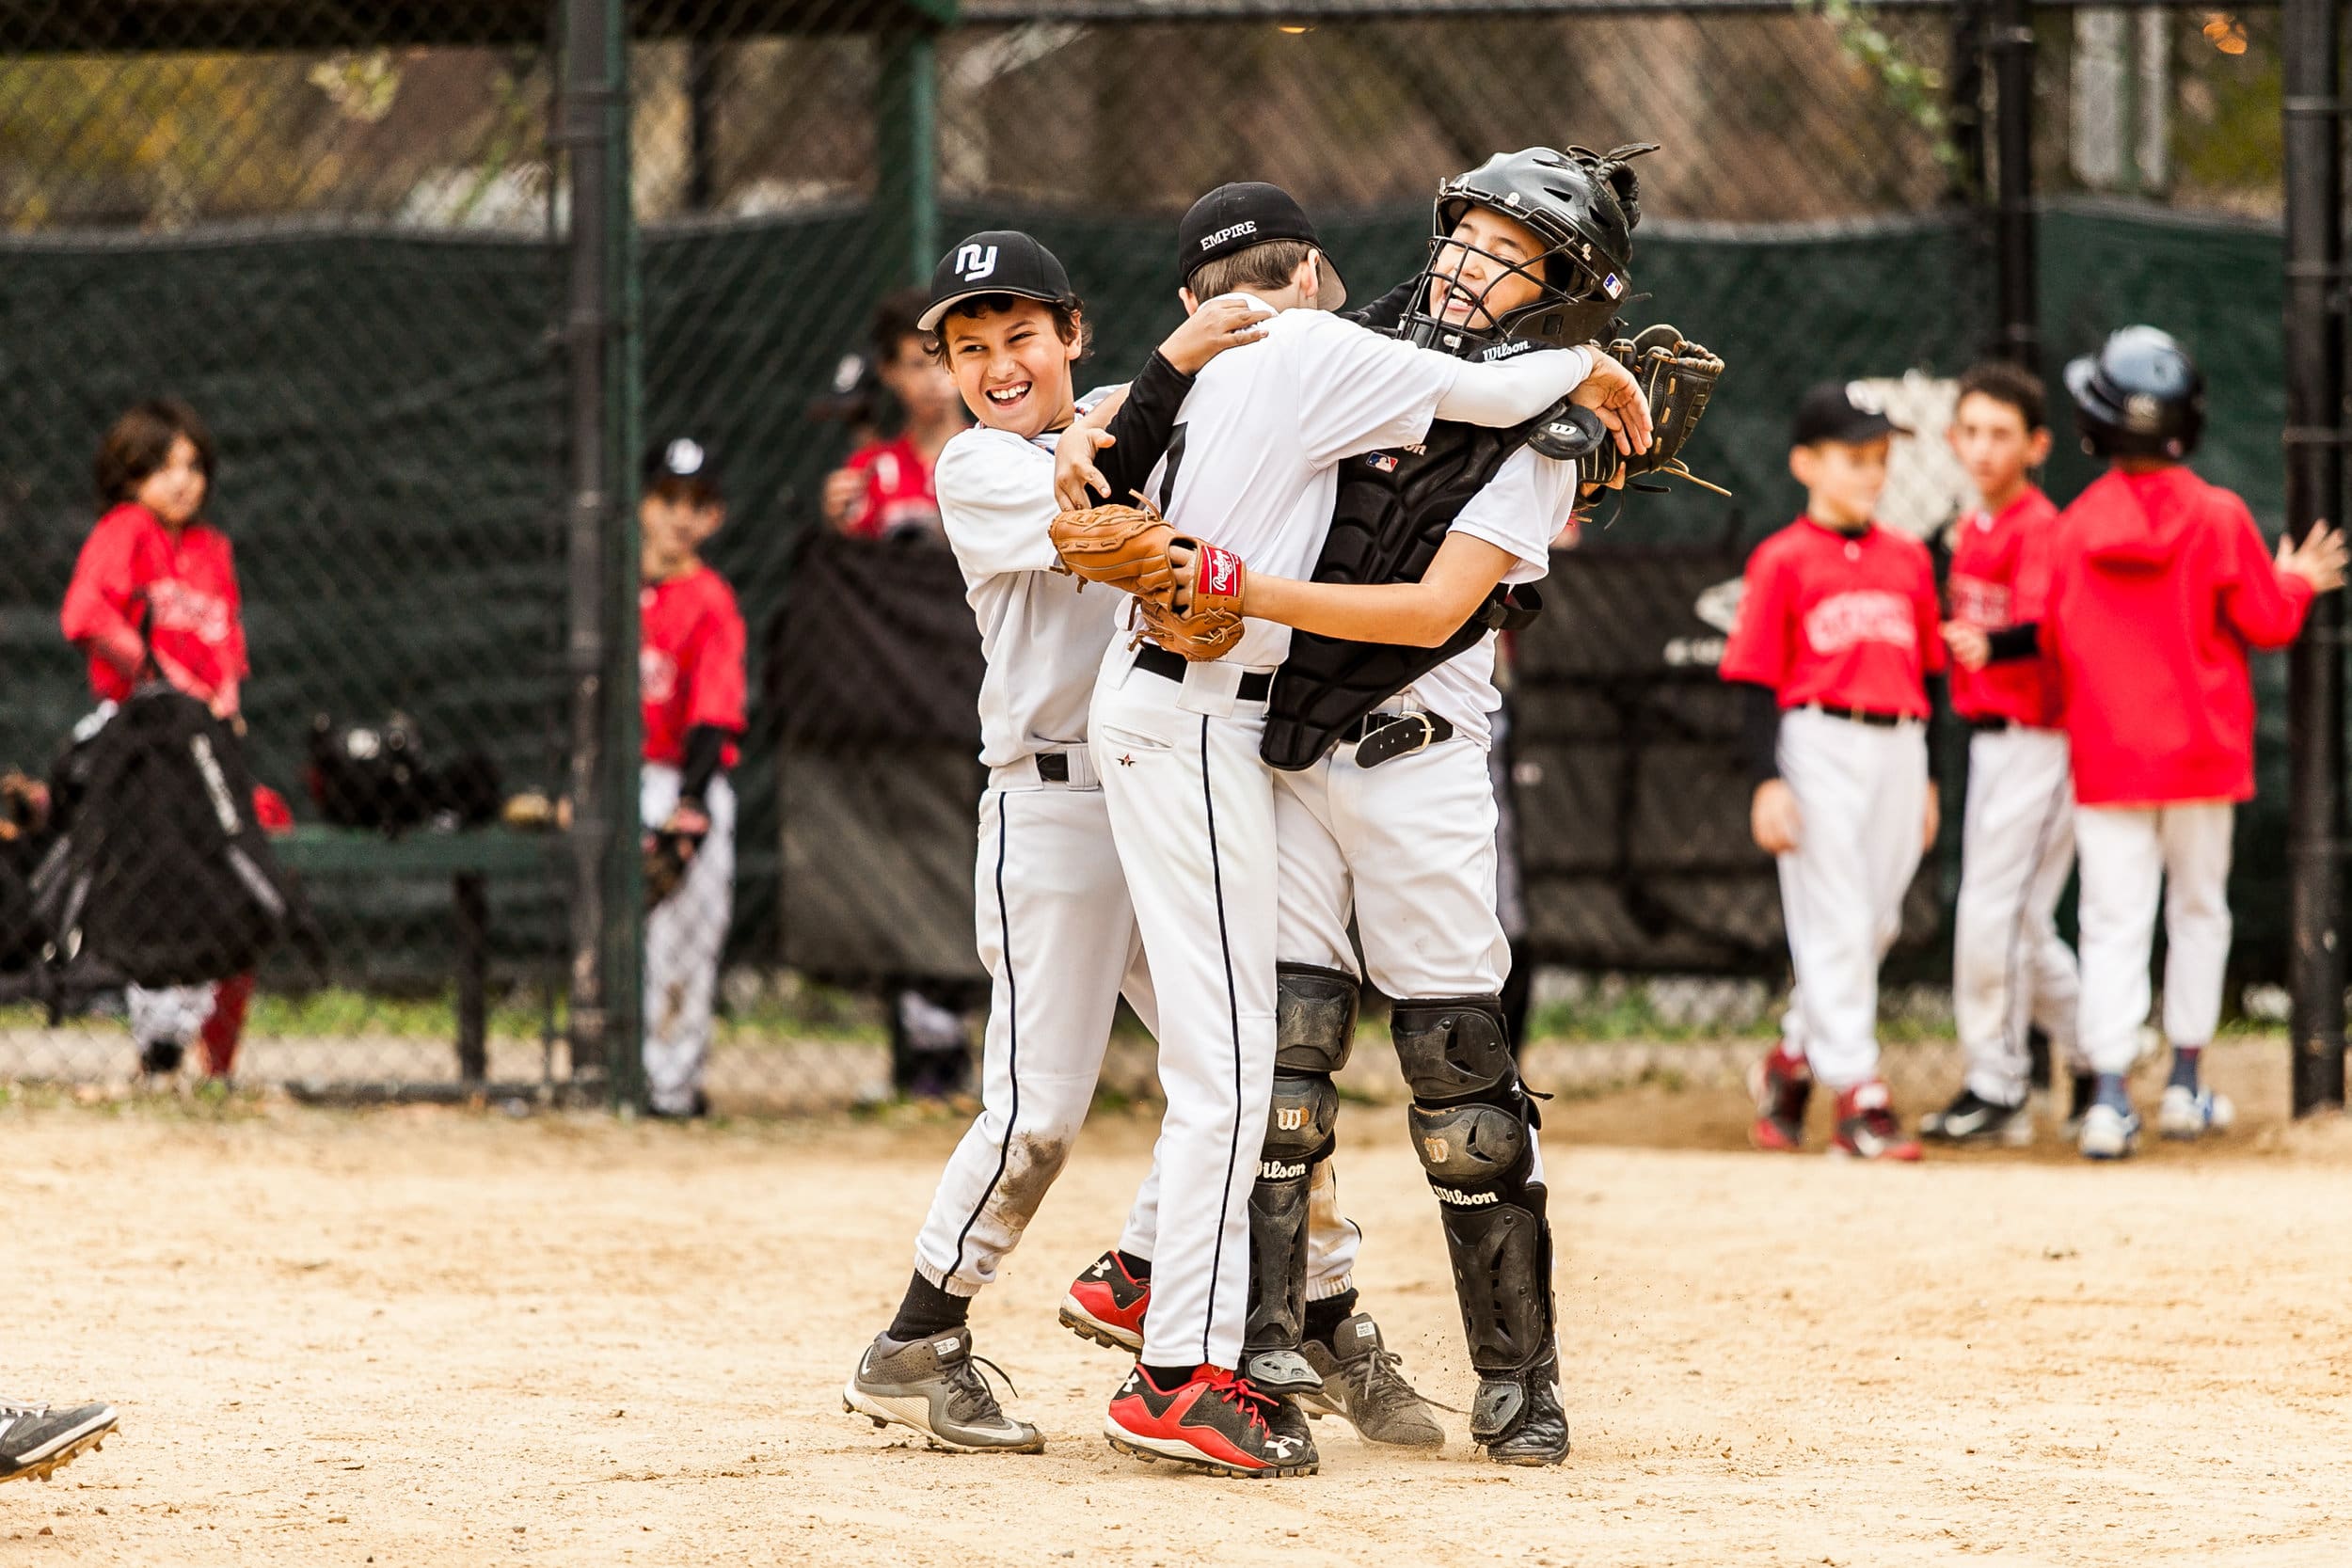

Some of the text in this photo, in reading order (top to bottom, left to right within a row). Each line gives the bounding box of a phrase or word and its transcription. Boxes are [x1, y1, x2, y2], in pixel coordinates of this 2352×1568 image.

[1200, 220, 1257, 251] EMPIRE
[1483, 340, 1529, 361] Wilson
[1433, 1185, 1499, 1205] Wilson
